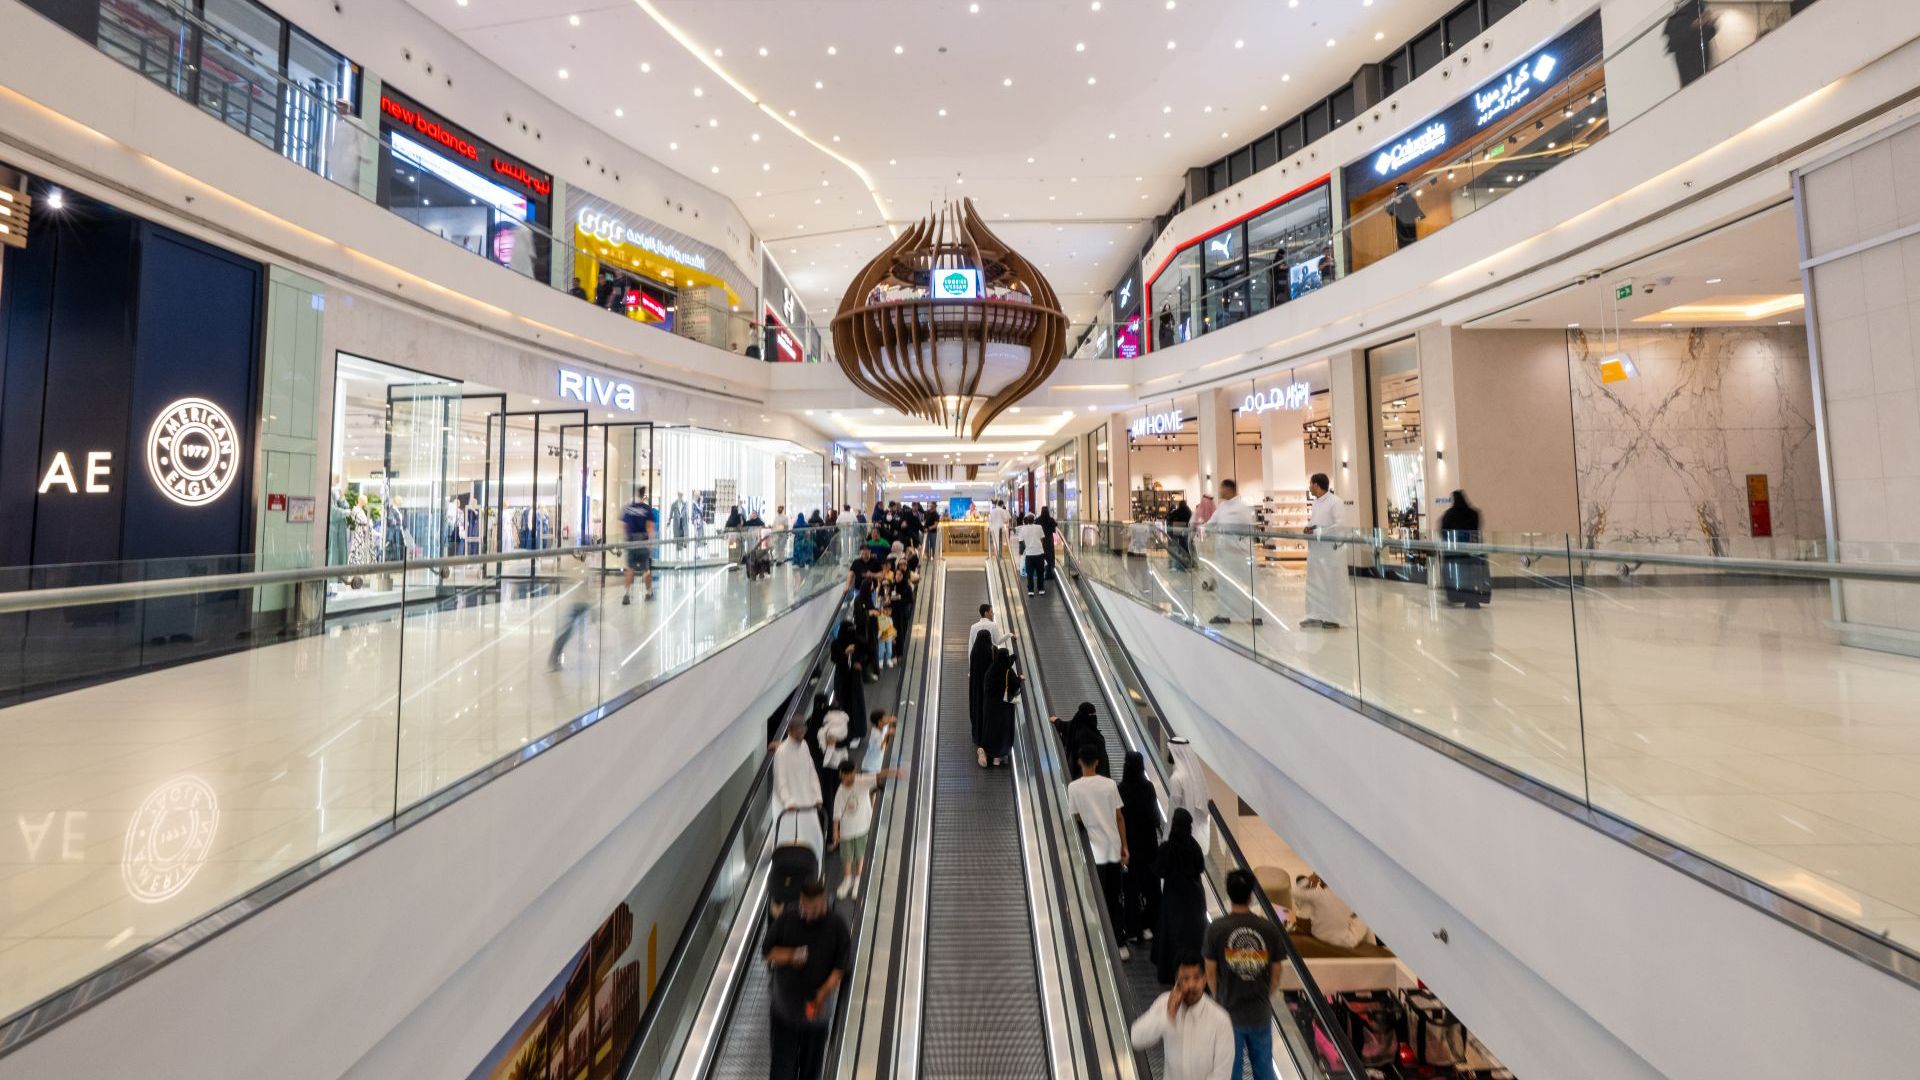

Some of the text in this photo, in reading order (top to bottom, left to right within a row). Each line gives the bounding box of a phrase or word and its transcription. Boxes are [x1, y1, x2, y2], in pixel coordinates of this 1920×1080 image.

[380, 96, 415, 125] new
[531, 178, 550, 196] نيو
[158, 406, 232, 455] AMERICAN
[1147, 410, 1184, 434] HOME
[182, 444, 209, 459] 1977
[38, 451, 112, 494] AE
[164, 469, 222, 497] EAGLE
